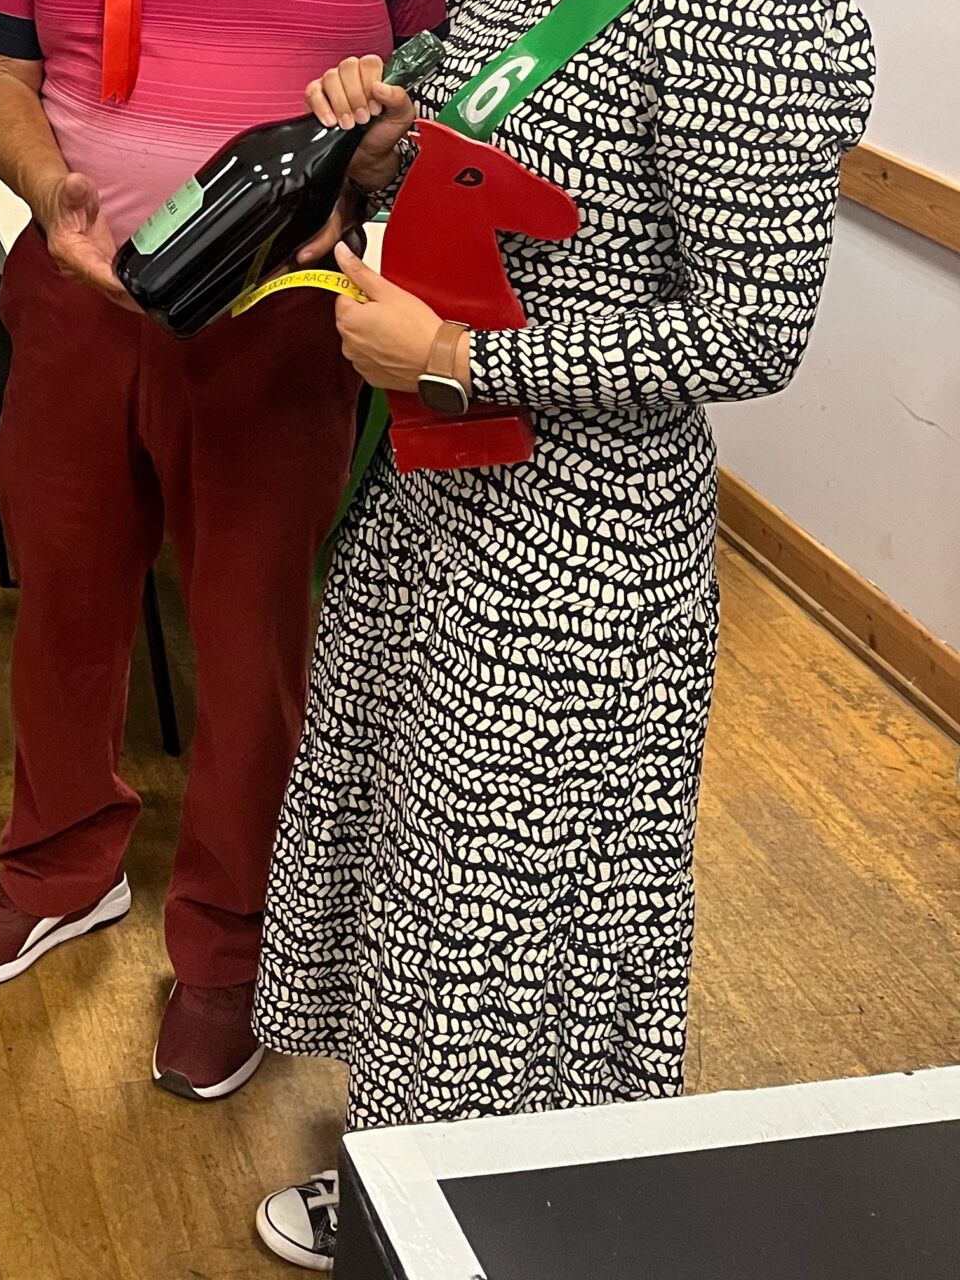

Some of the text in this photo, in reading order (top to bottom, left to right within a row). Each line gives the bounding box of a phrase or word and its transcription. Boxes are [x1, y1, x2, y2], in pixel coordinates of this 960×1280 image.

[465, 55, 535, 124] 6
[303, 272, 331, 284] RACE
[335, 277, 349, 289] 10
